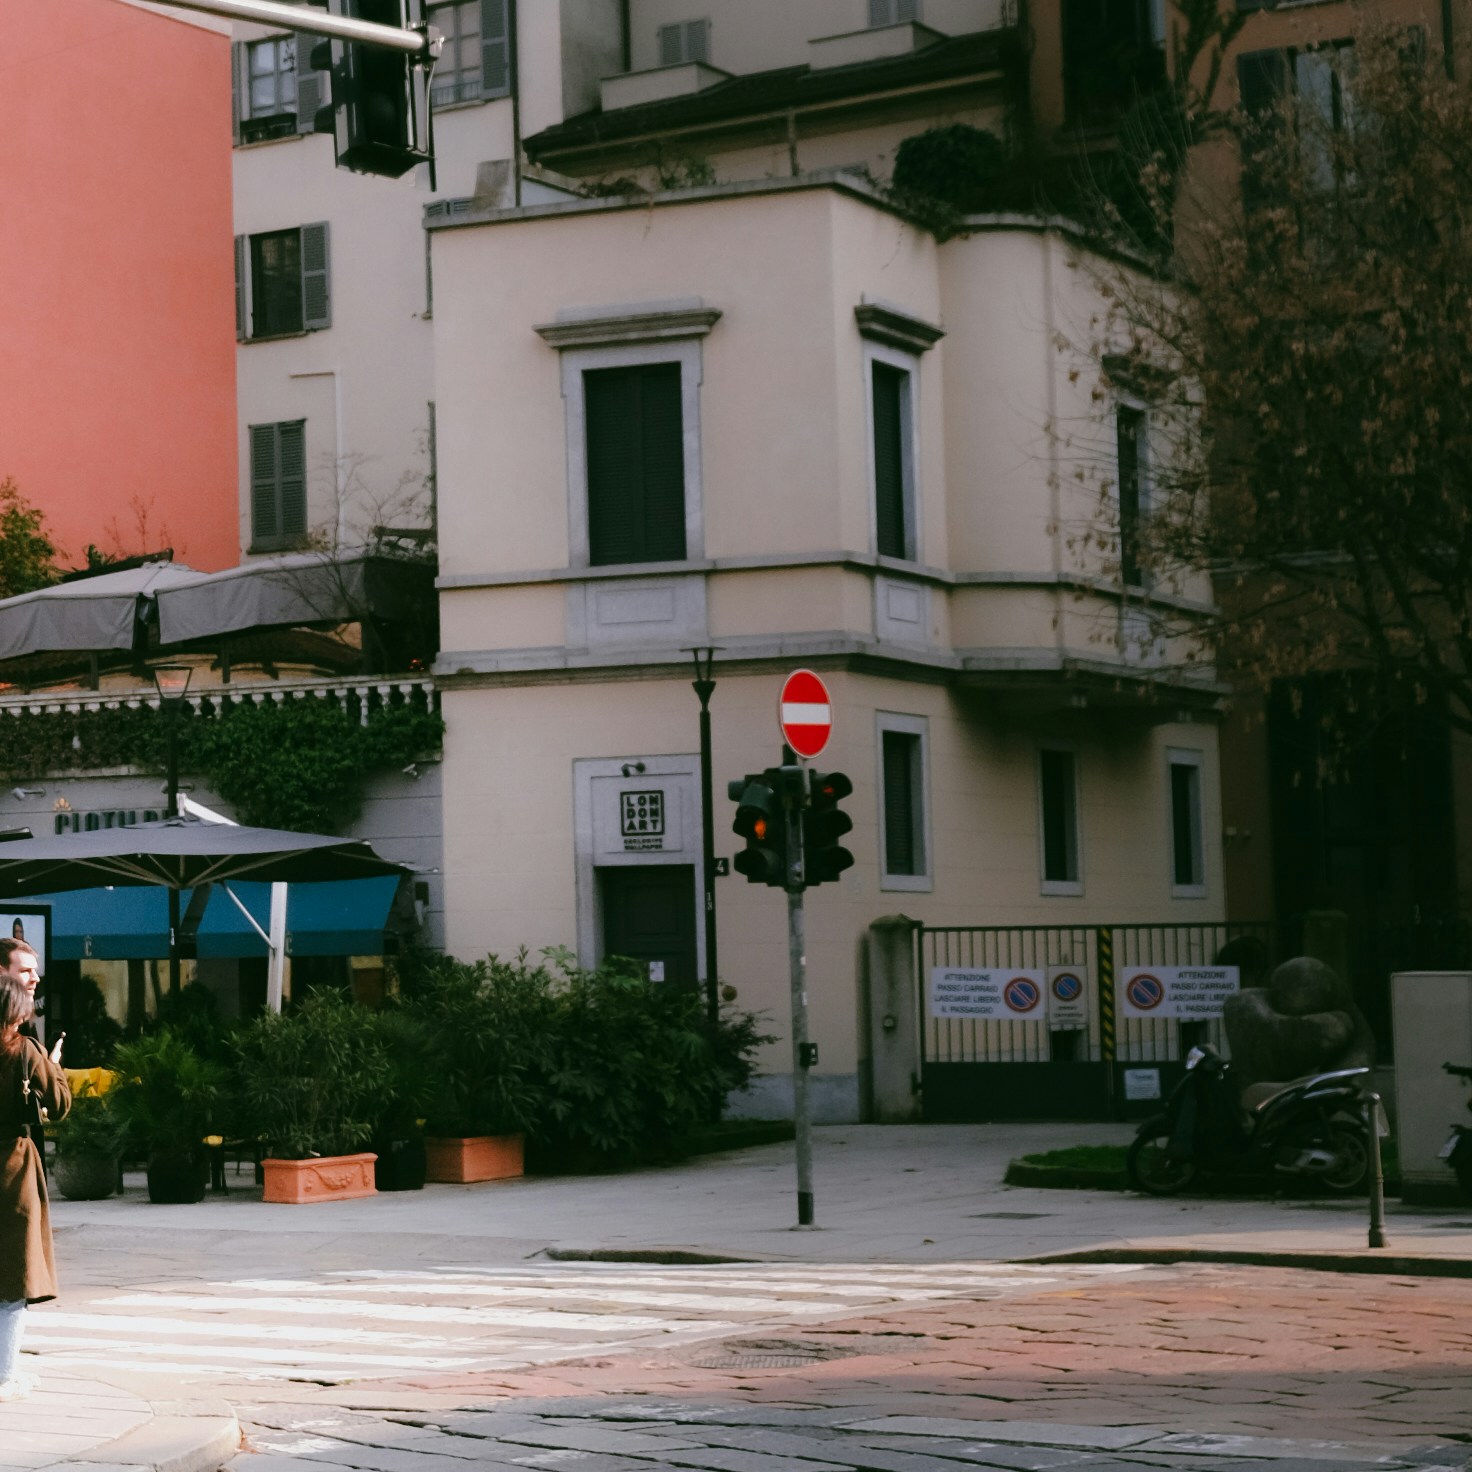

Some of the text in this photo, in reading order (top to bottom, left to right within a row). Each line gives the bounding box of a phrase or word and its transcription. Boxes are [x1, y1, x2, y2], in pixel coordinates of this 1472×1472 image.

[626, 795, 659, 807] LON
[626, 808, 659, 819] DON
[627, 819, 659, 831] ART
[716, 860, 725, 873] 4
[944, 973, 992, 982] ATTENZIONE
[1177, 971, 1226, 980] ATTENZIONE
[937, 984, 999, 993] PASSO CARRAIO
[1170, 982, 1236, 991] PASSO CARRAIO
[933, 995, 1002, 1004] LASCIARE LIBERO
[1168, 993, 1207, 1002] LASCIARE
[940, 1005, 994, 1015] IL PASSAGGIO
